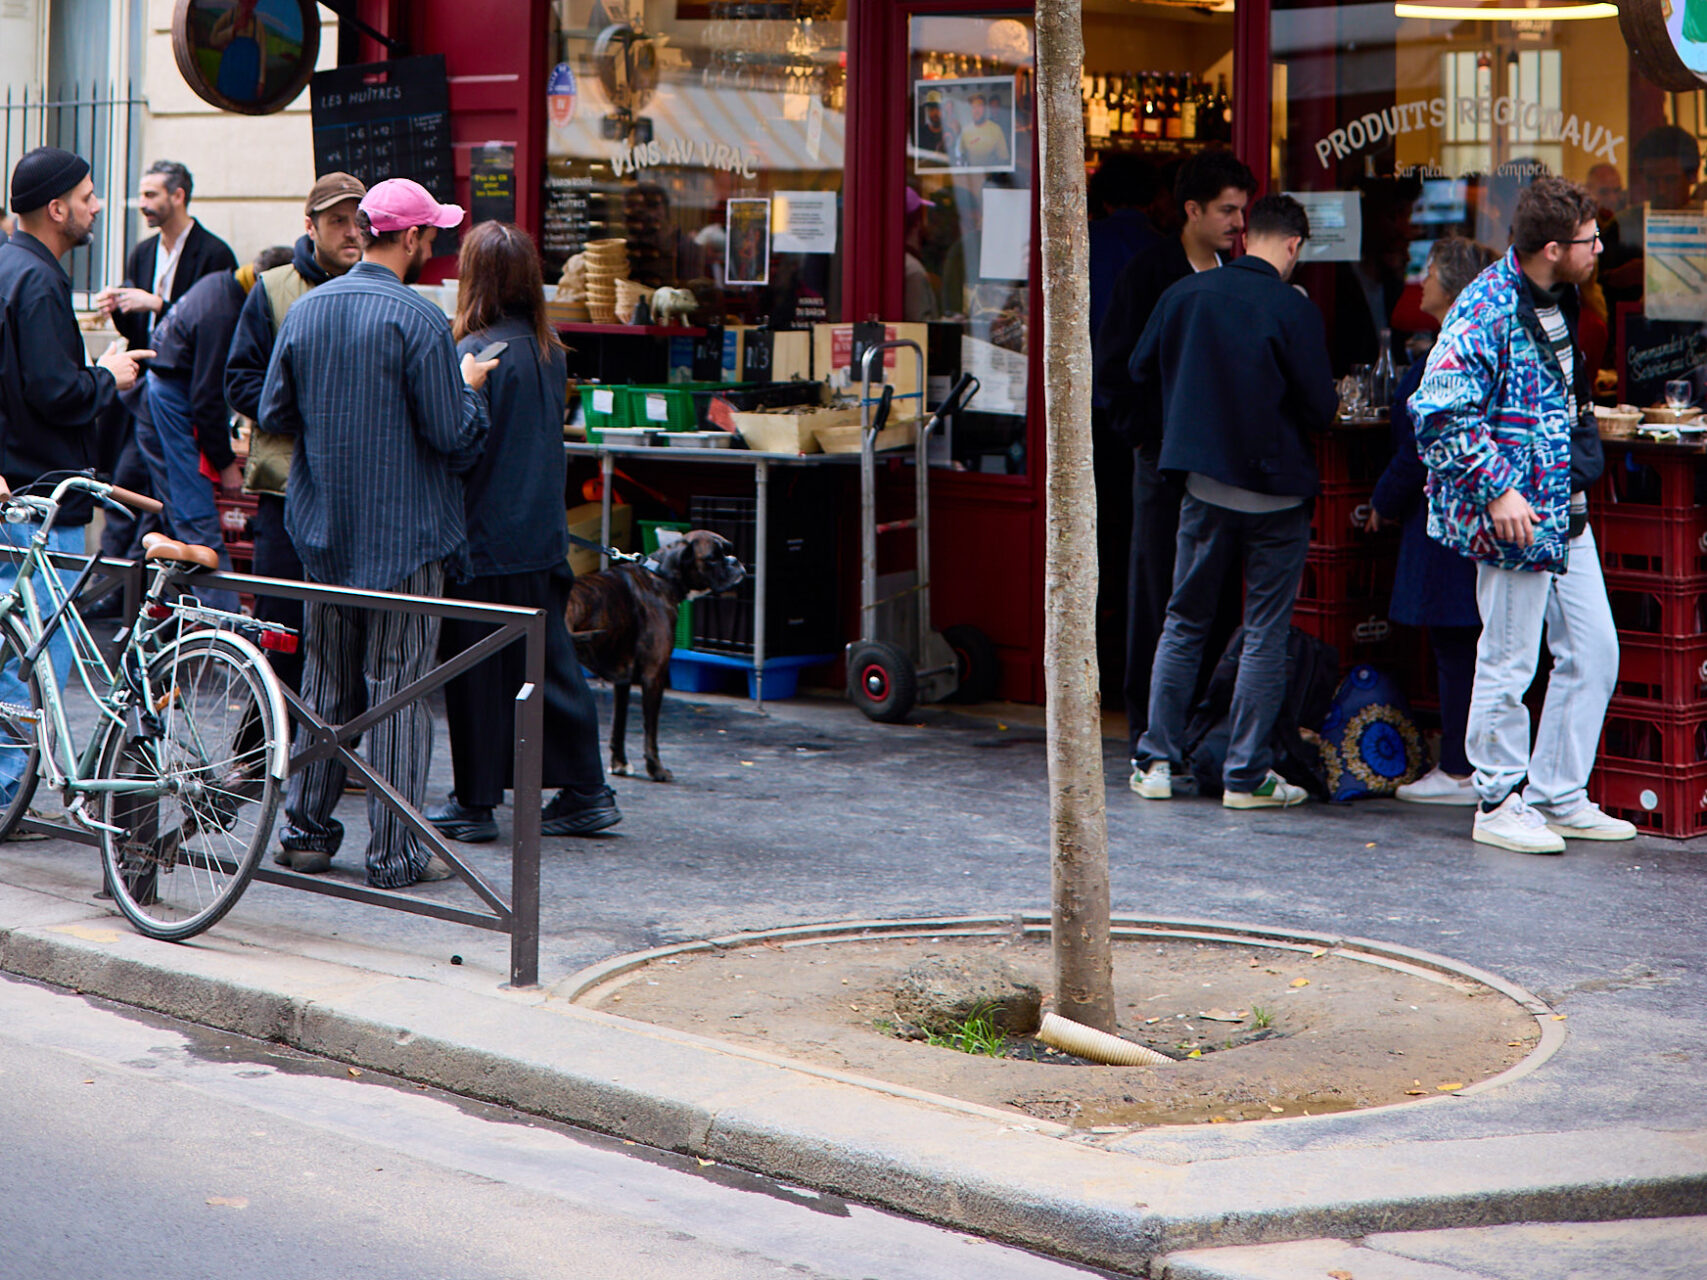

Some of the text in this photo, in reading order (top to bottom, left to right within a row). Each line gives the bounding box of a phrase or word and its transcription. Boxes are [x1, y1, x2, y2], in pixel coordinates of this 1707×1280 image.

[321, 94, 343, 109] LES
[1314, 97, 1446, 169] PRODUITS
[611, 138, 661, 177] VINS
[701, 142, 757, 180] VRAC
